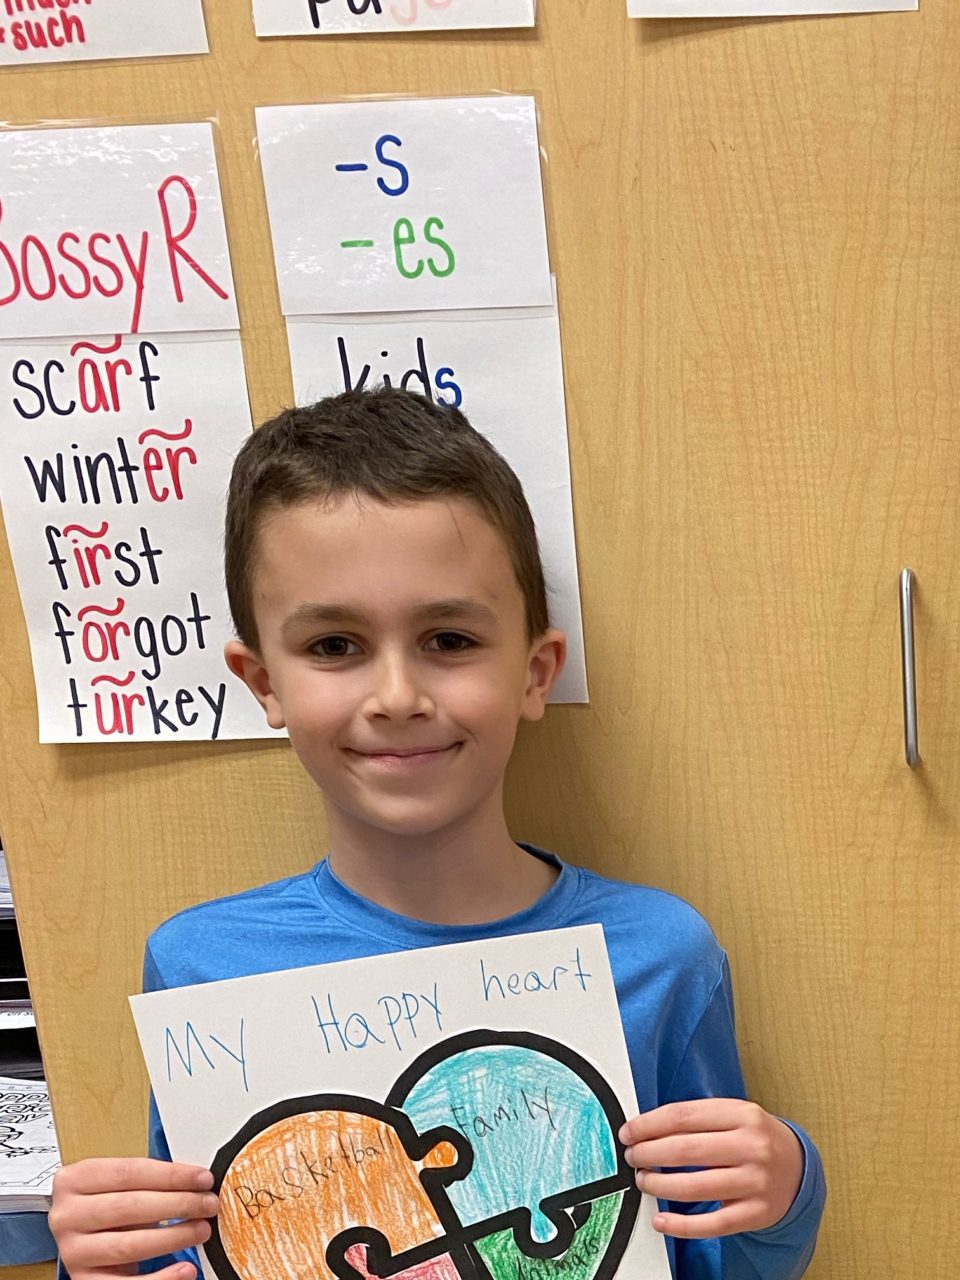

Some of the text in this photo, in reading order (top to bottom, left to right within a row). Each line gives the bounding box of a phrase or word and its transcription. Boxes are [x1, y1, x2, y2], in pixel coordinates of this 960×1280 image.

[11, 10, 86, 51] such
[0, 175, 229, 333] ossy R
[12, 335, 160, 419] scarf
[24, 419, 196, 504] winter
[45, 522, 163, 590] first
[52, 593, 211, 680] forgot
[67, 672, 226, 740] turkey
[480, 948, 592, 1001] heart
